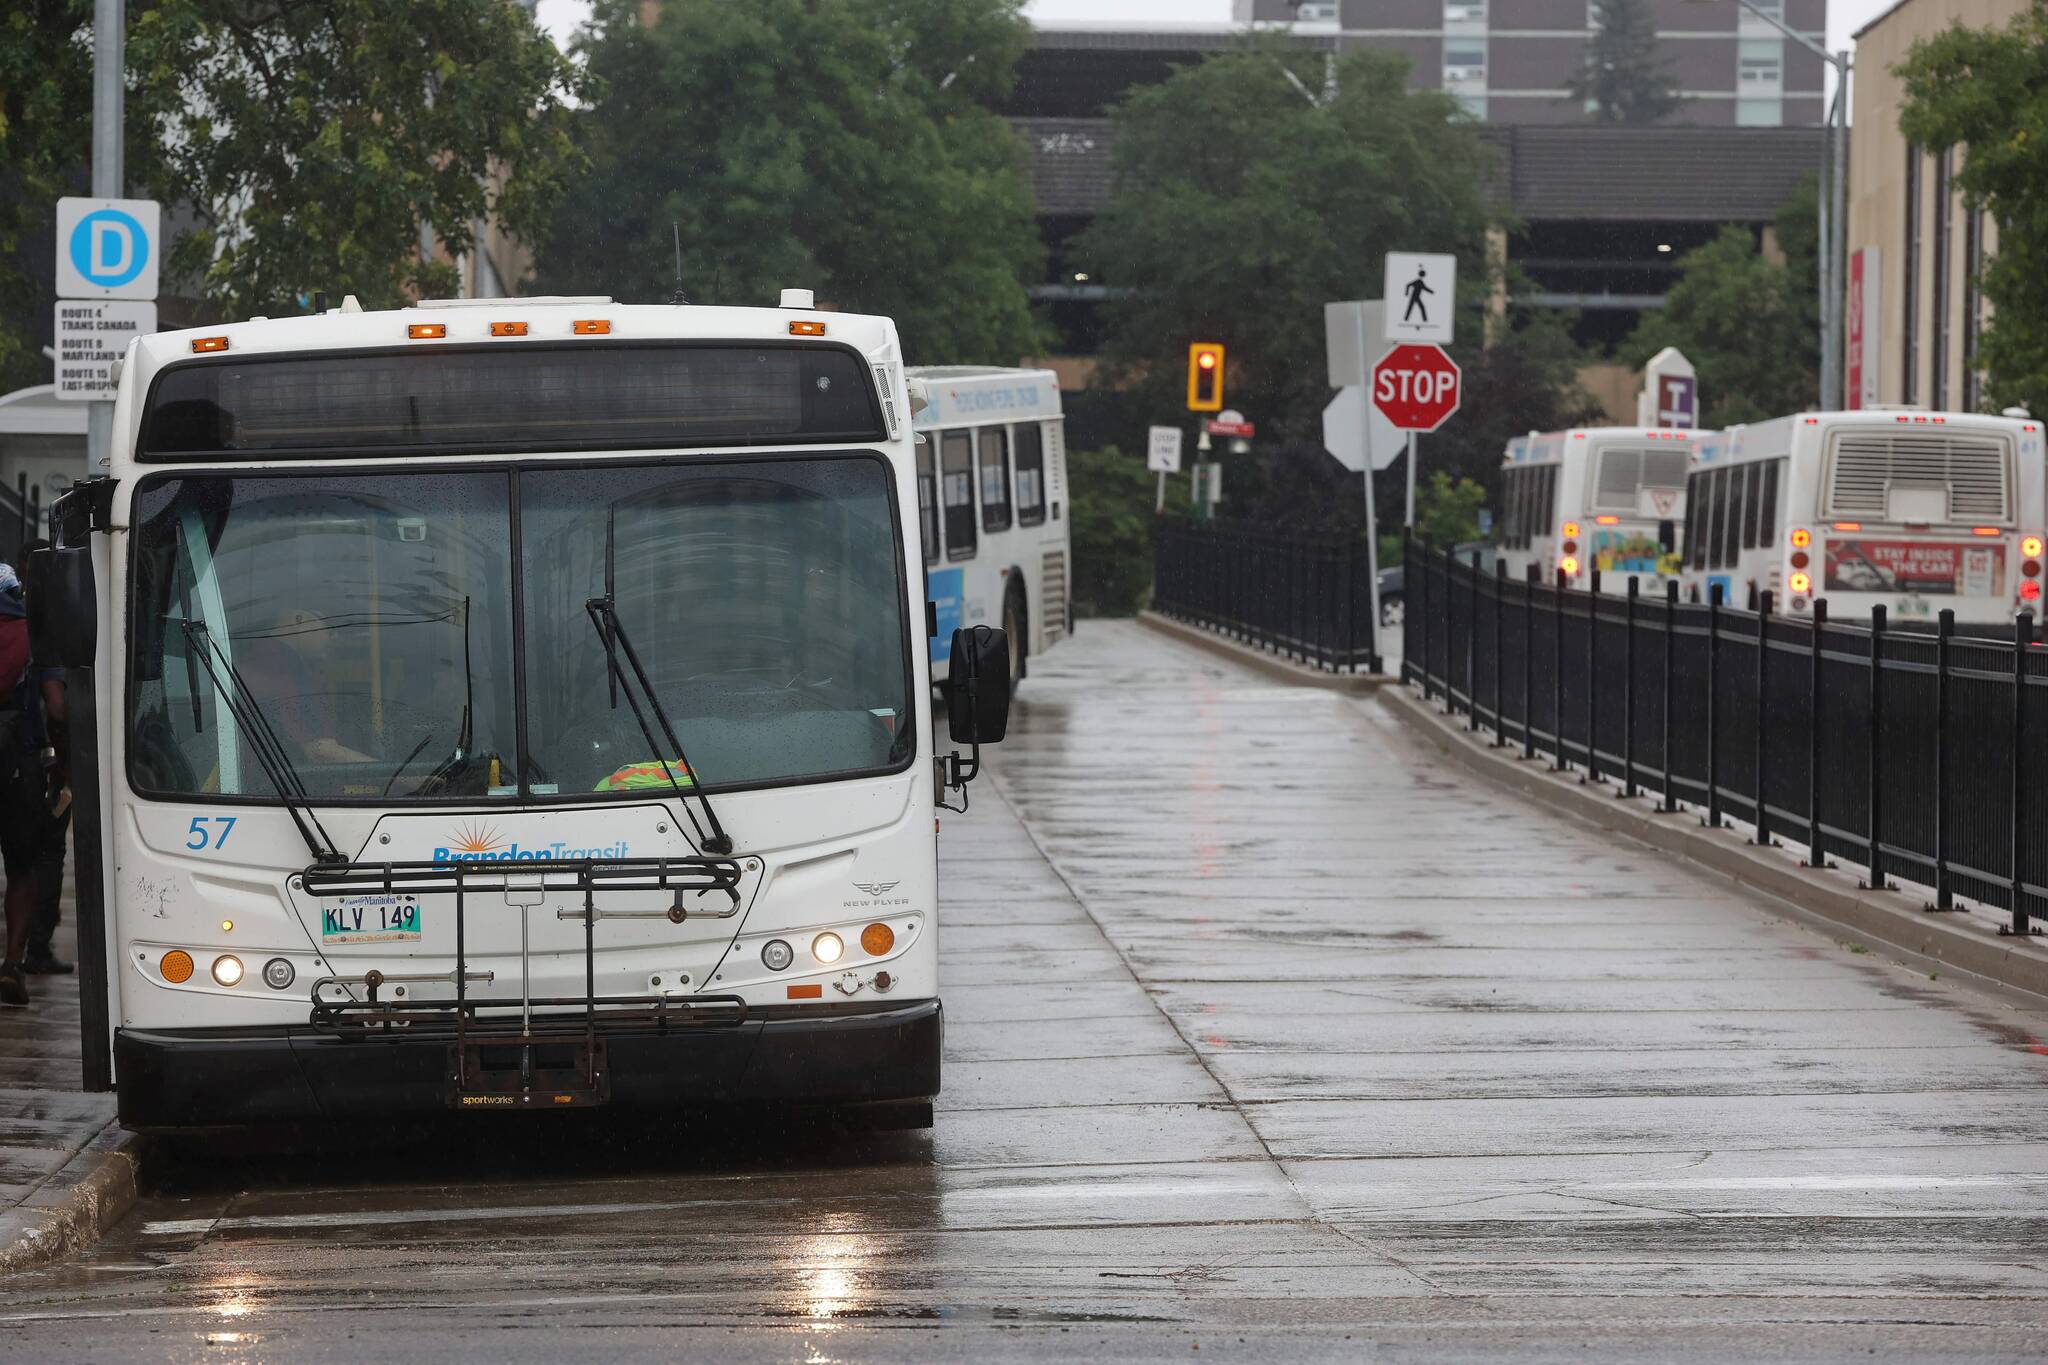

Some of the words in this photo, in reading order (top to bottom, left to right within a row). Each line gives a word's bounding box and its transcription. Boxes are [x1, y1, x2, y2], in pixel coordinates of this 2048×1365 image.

[90, 219, 134, 277] D
[61, 308, 93, 318] ROUTE
[96, 308, 102, 318] 4
[62, 321, 94, 330] TRANS
[97, 321, 137, 330] CANADA
[62, 339, 93, 349] ROUTE
[62, 351, 116, 361] MARYLAND
[62, 369, 93, 378] ROUTE
[1376, 368, 1455, 404] STOP
[1874, 547, 1904, 560] STAY
[1908, 549, 1954, 561] INSIDE
[1892, 561, 1917, 574] THE
[186, 816, 238, 850] 57
[364, 895, 396, 905] Manitoba
[842, 899, 870, 907] NEW
[873, 898, 909, 906] FLYER
[326, 907, 364, 931] KLV
[380, 905, 415, 929] 149
[462, 1095, 514, 1105] sportworks
